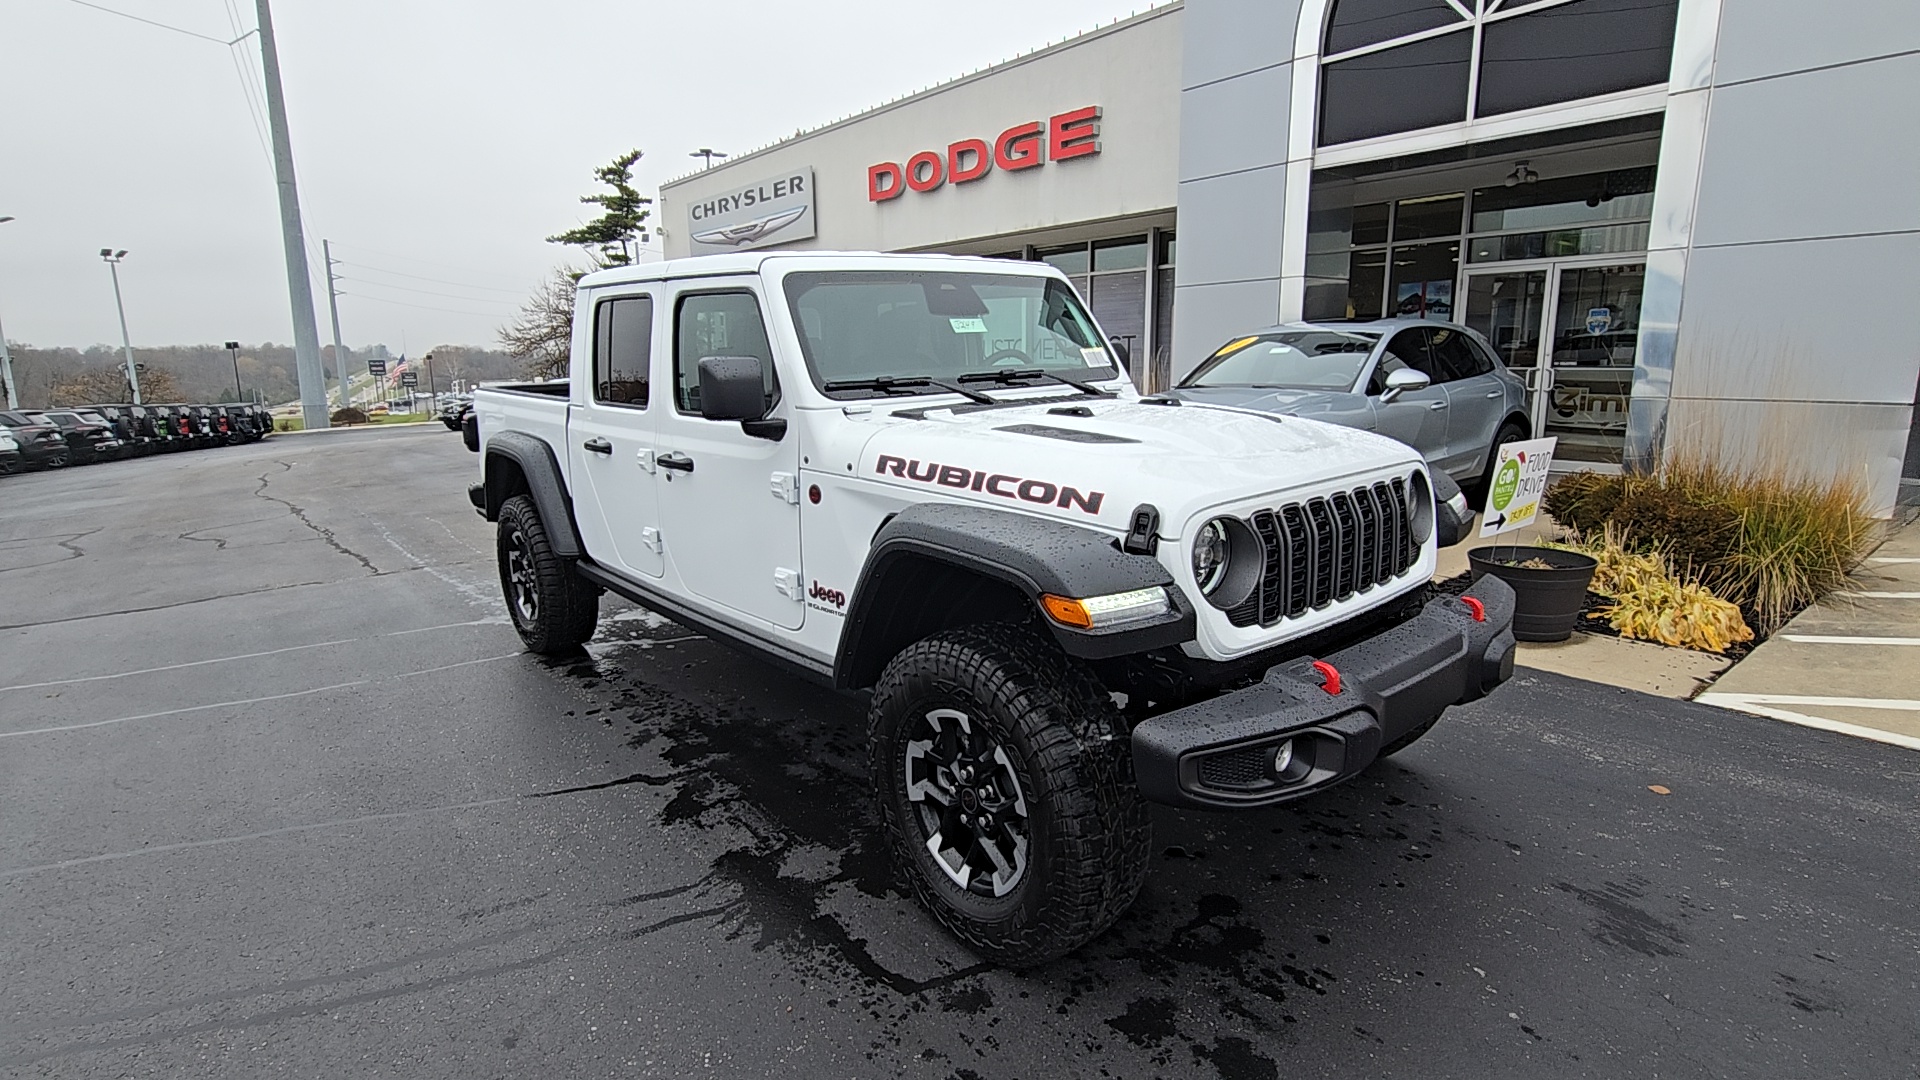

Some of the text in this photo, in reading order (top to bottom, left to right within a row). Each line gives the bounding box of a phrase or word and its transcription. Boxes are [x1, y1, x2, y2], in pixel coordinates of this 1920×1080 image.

[868, 105, 1102, 203] DODGE
[691, 175, 805, 221] CHRYSLER
[1526, 451, 1552, 473] FOOD
[875, 454, 1105, 516] RUBICON
[1516, 474, 1545, 498] DRIVE
[808, 580, 846, 609] Jeep
